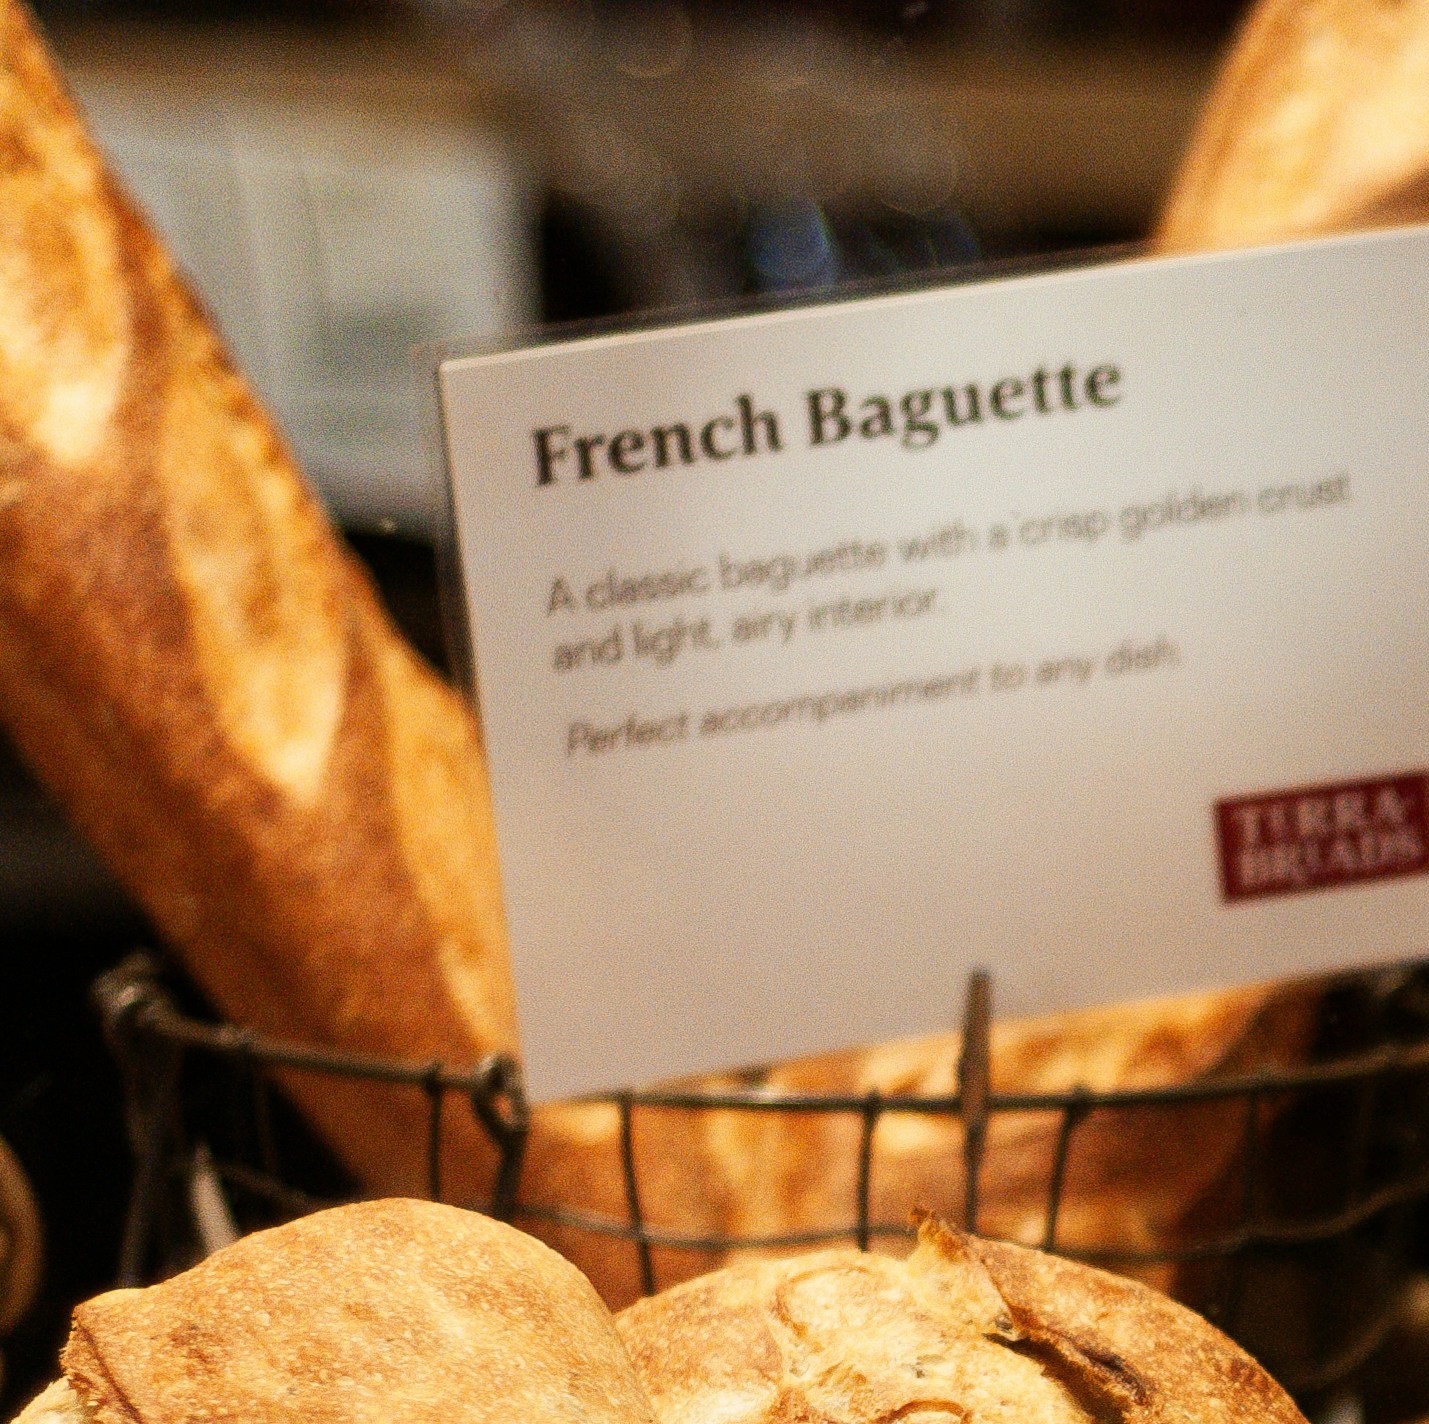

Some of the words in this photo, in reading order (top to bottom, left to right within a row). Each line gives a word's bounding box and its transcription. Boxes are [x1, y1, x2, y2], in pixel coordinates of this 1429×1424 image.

[532, 393, 783, 486] French
[806, 362, 1124, 448] Baguette
[548, 577, 574, 617] A
[584, 562, 709, 610] classic
[719, 535, 887, 596] baguette
[901, 520, 978, 566] with
[1019, 506, 1108, 549] crisp
[1119, 488, 1245, 541] golden
[1258, 473, 1352, 514] crust
[554, 627, 621, 672] and
[732, 603, 794, 646] airy
[567, 710, 690, 758] Perfect
[700, 664, 982, 741] accompaniment
[990, 660, 1026, 692] to
[1036, 652, 1094, 689] any
